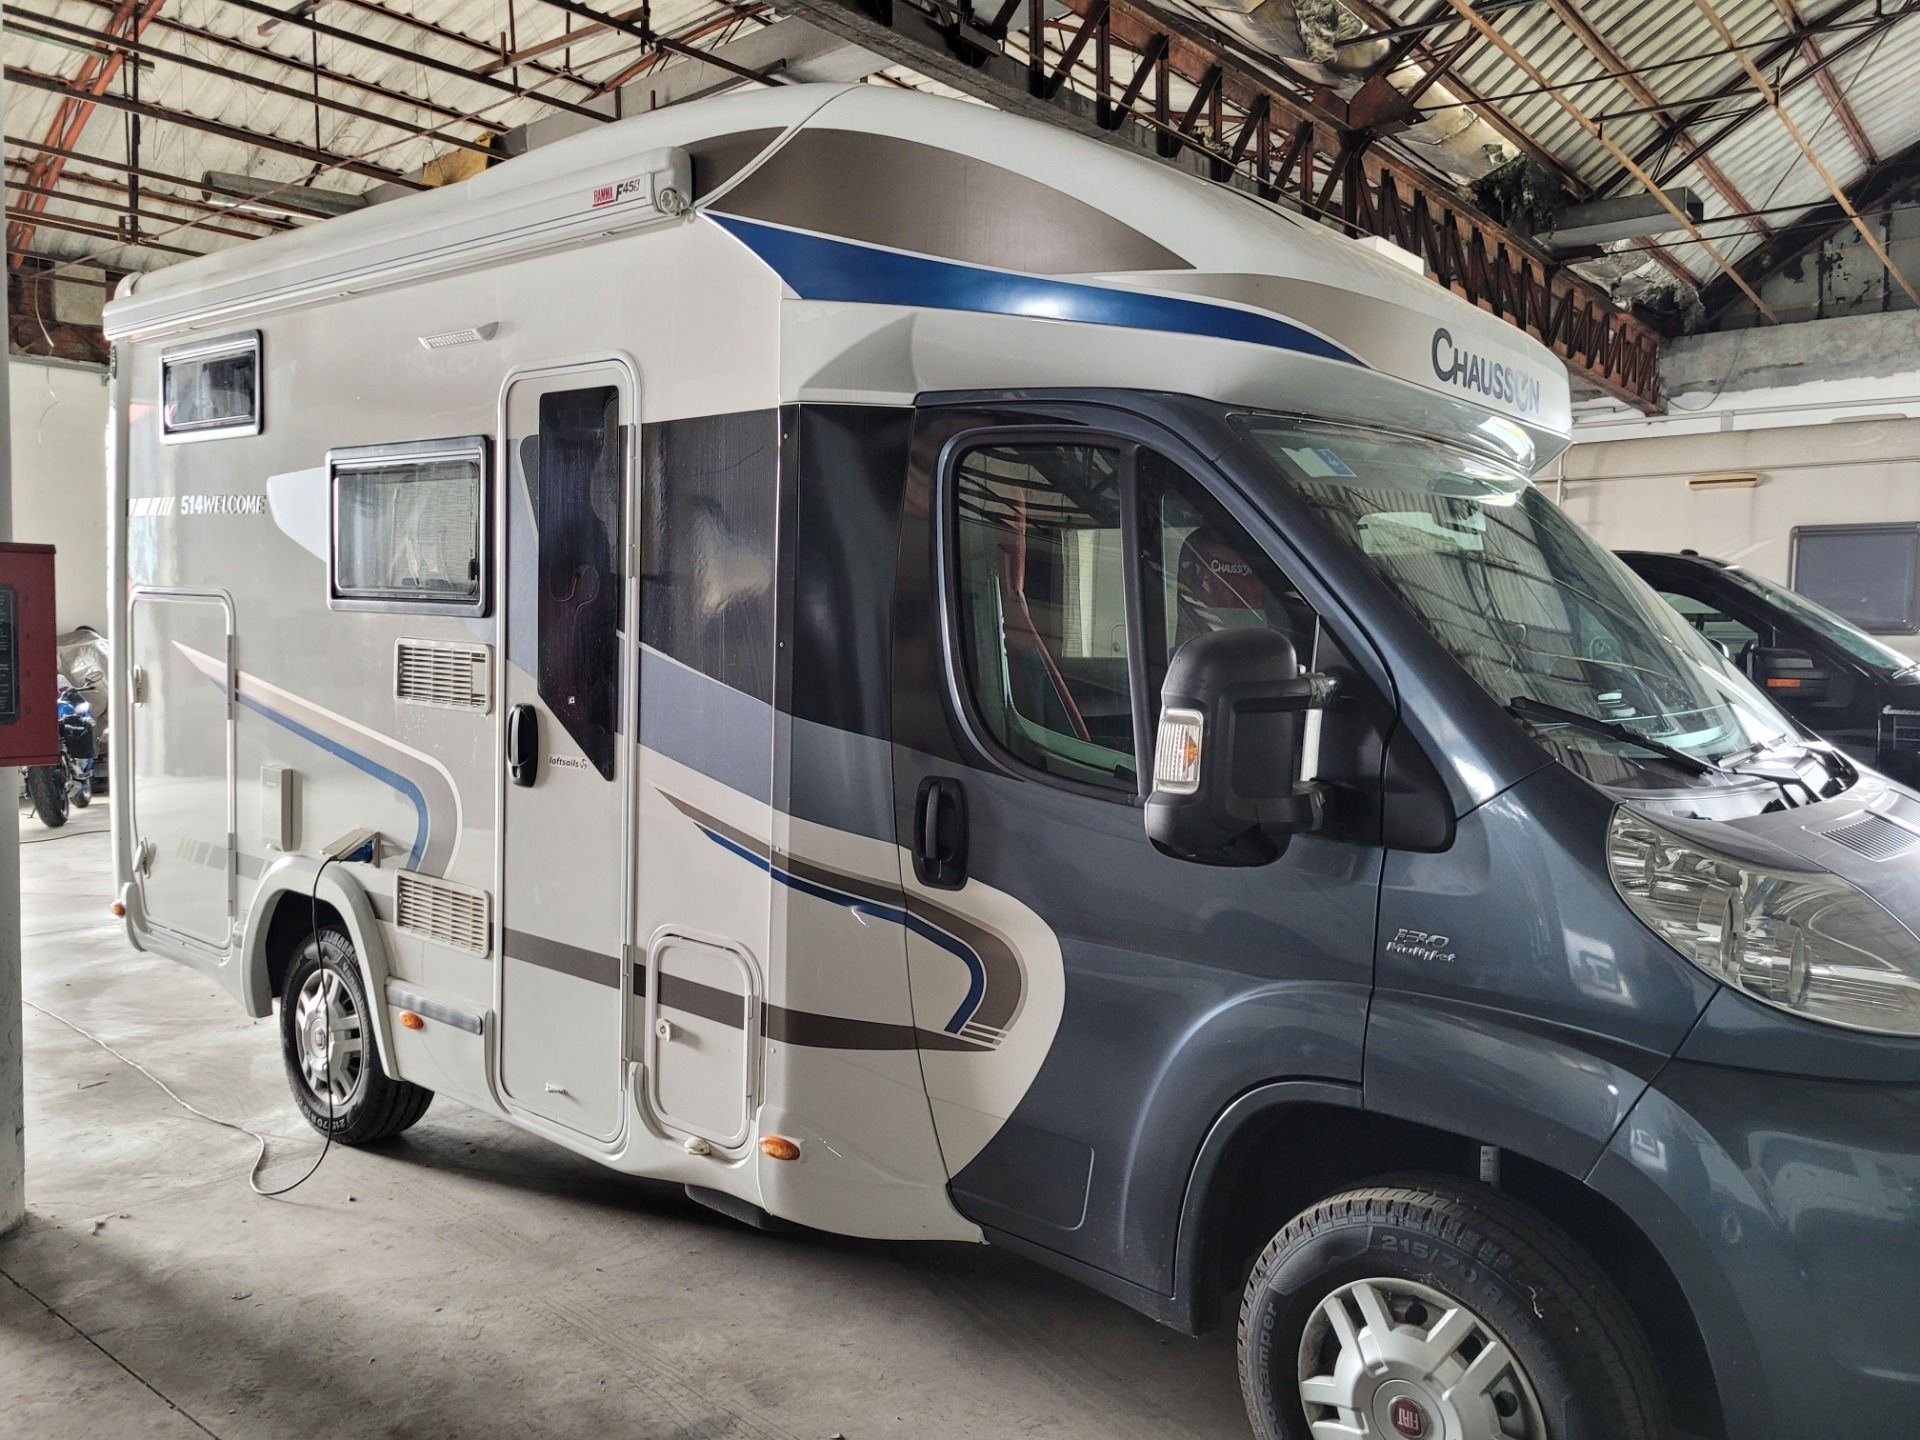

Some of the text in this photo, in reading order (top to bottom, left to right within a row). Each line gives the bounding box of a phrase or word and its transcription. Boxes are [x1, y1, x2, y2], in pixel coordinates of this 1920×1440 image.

[1431, 327, 1540, 414] CHAUSSON
[549, 756, 579, 768] loftsails
[1394, 928, 1450, 948] 130
[1398, 1407, 1419, 1430] FIAT
